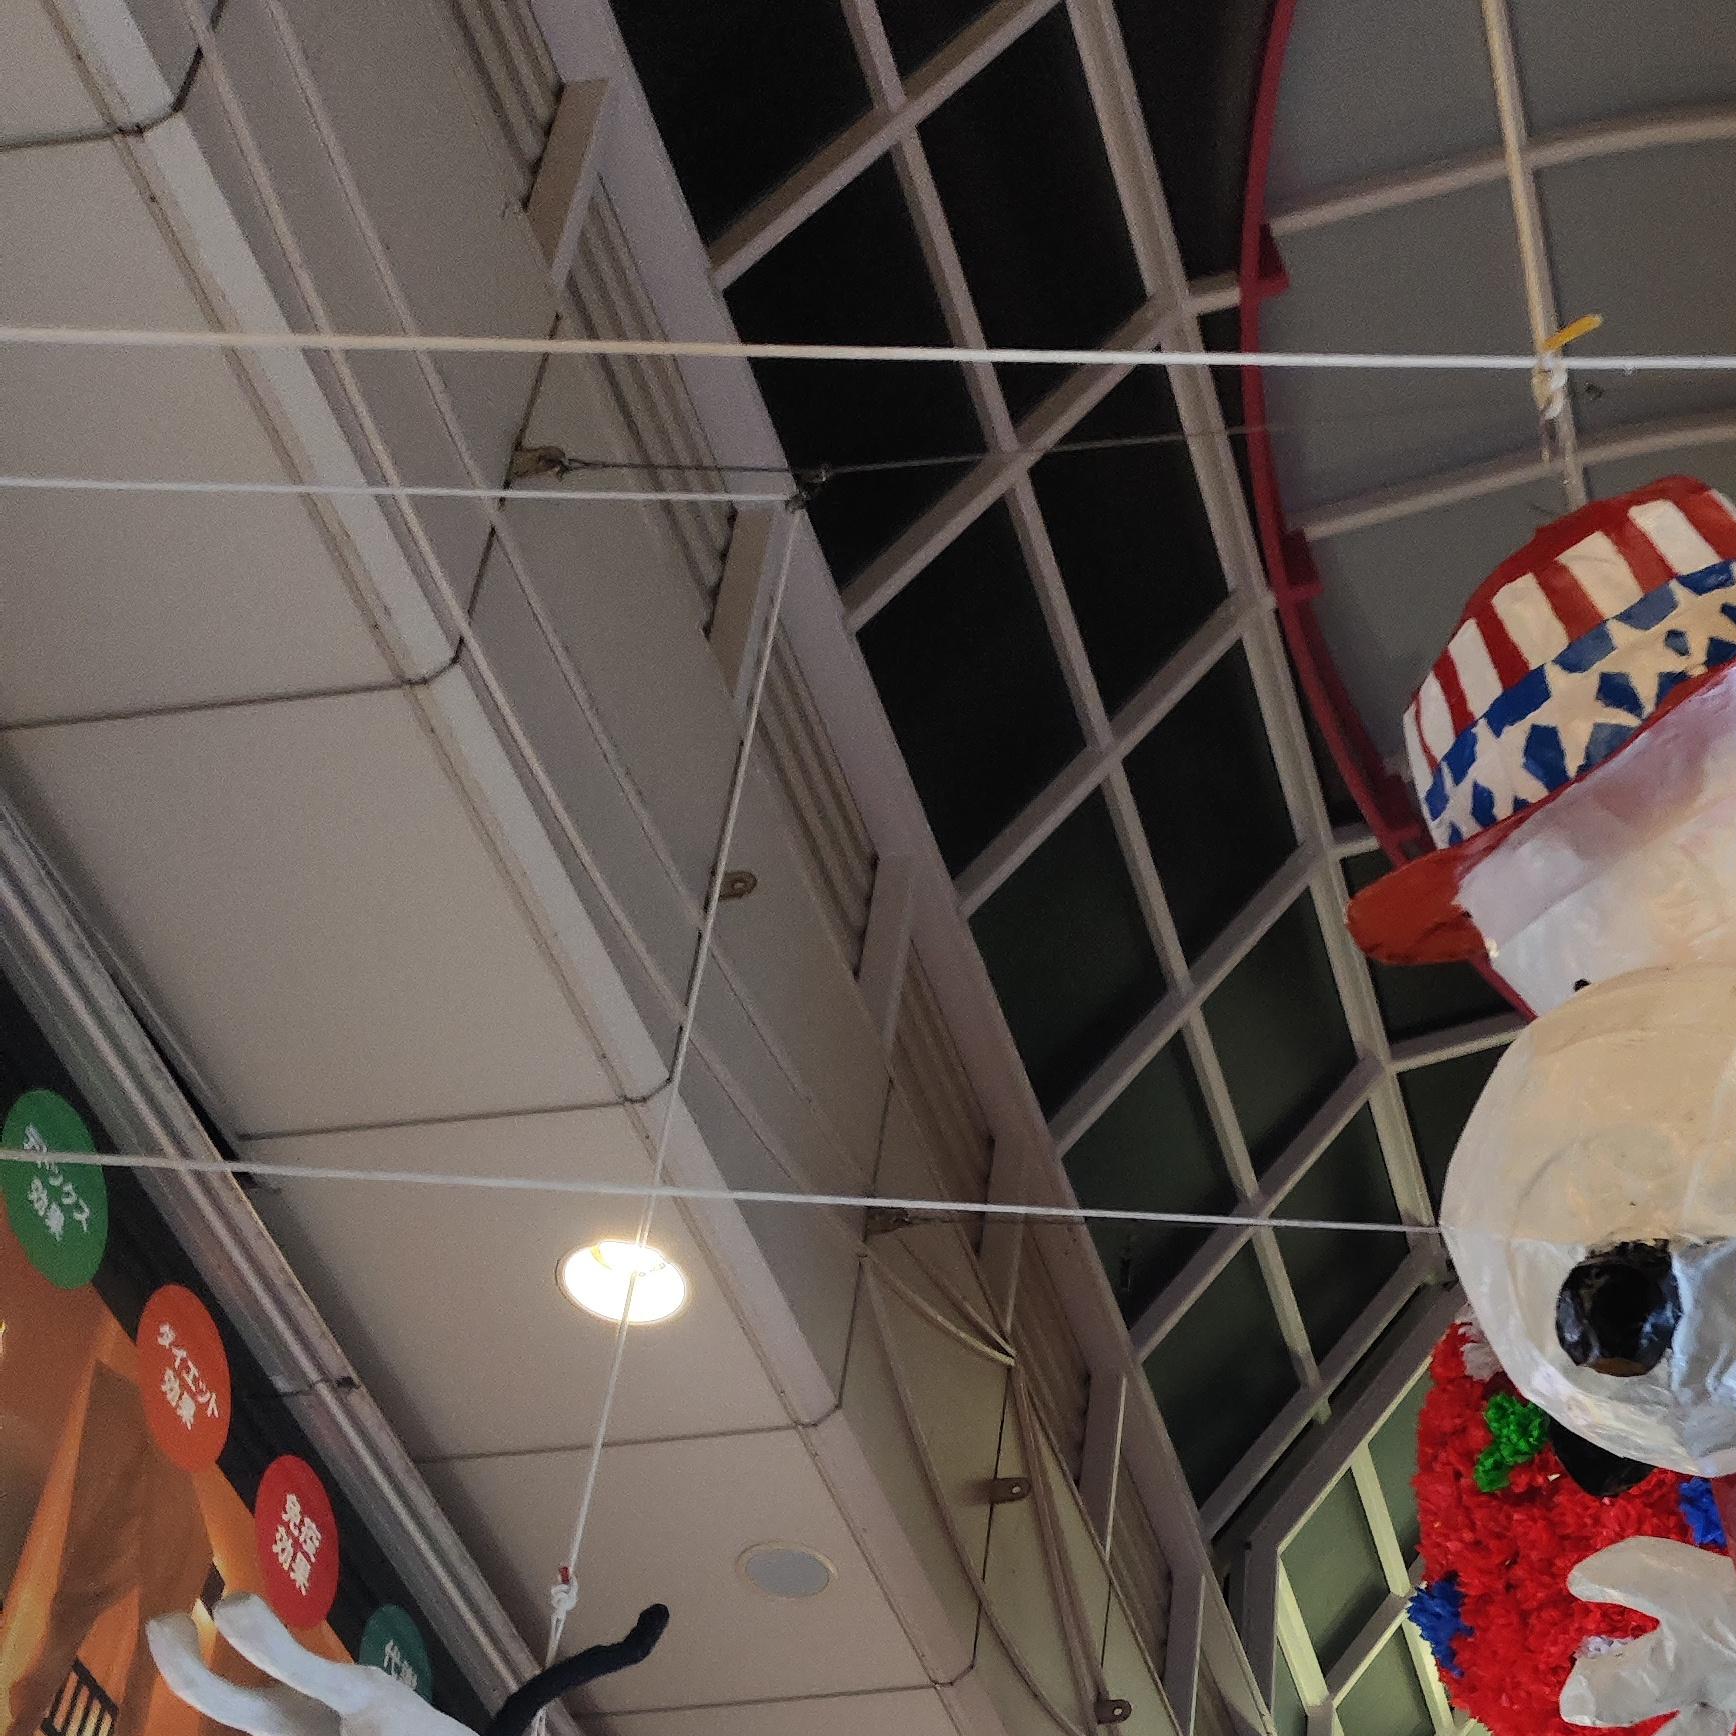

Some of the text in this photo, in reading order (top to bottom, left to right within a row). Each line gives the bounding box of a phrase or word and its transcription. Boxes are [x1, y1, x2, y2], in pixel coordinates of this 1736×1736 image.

[156, 1322, 220, 1419] ダイエット
